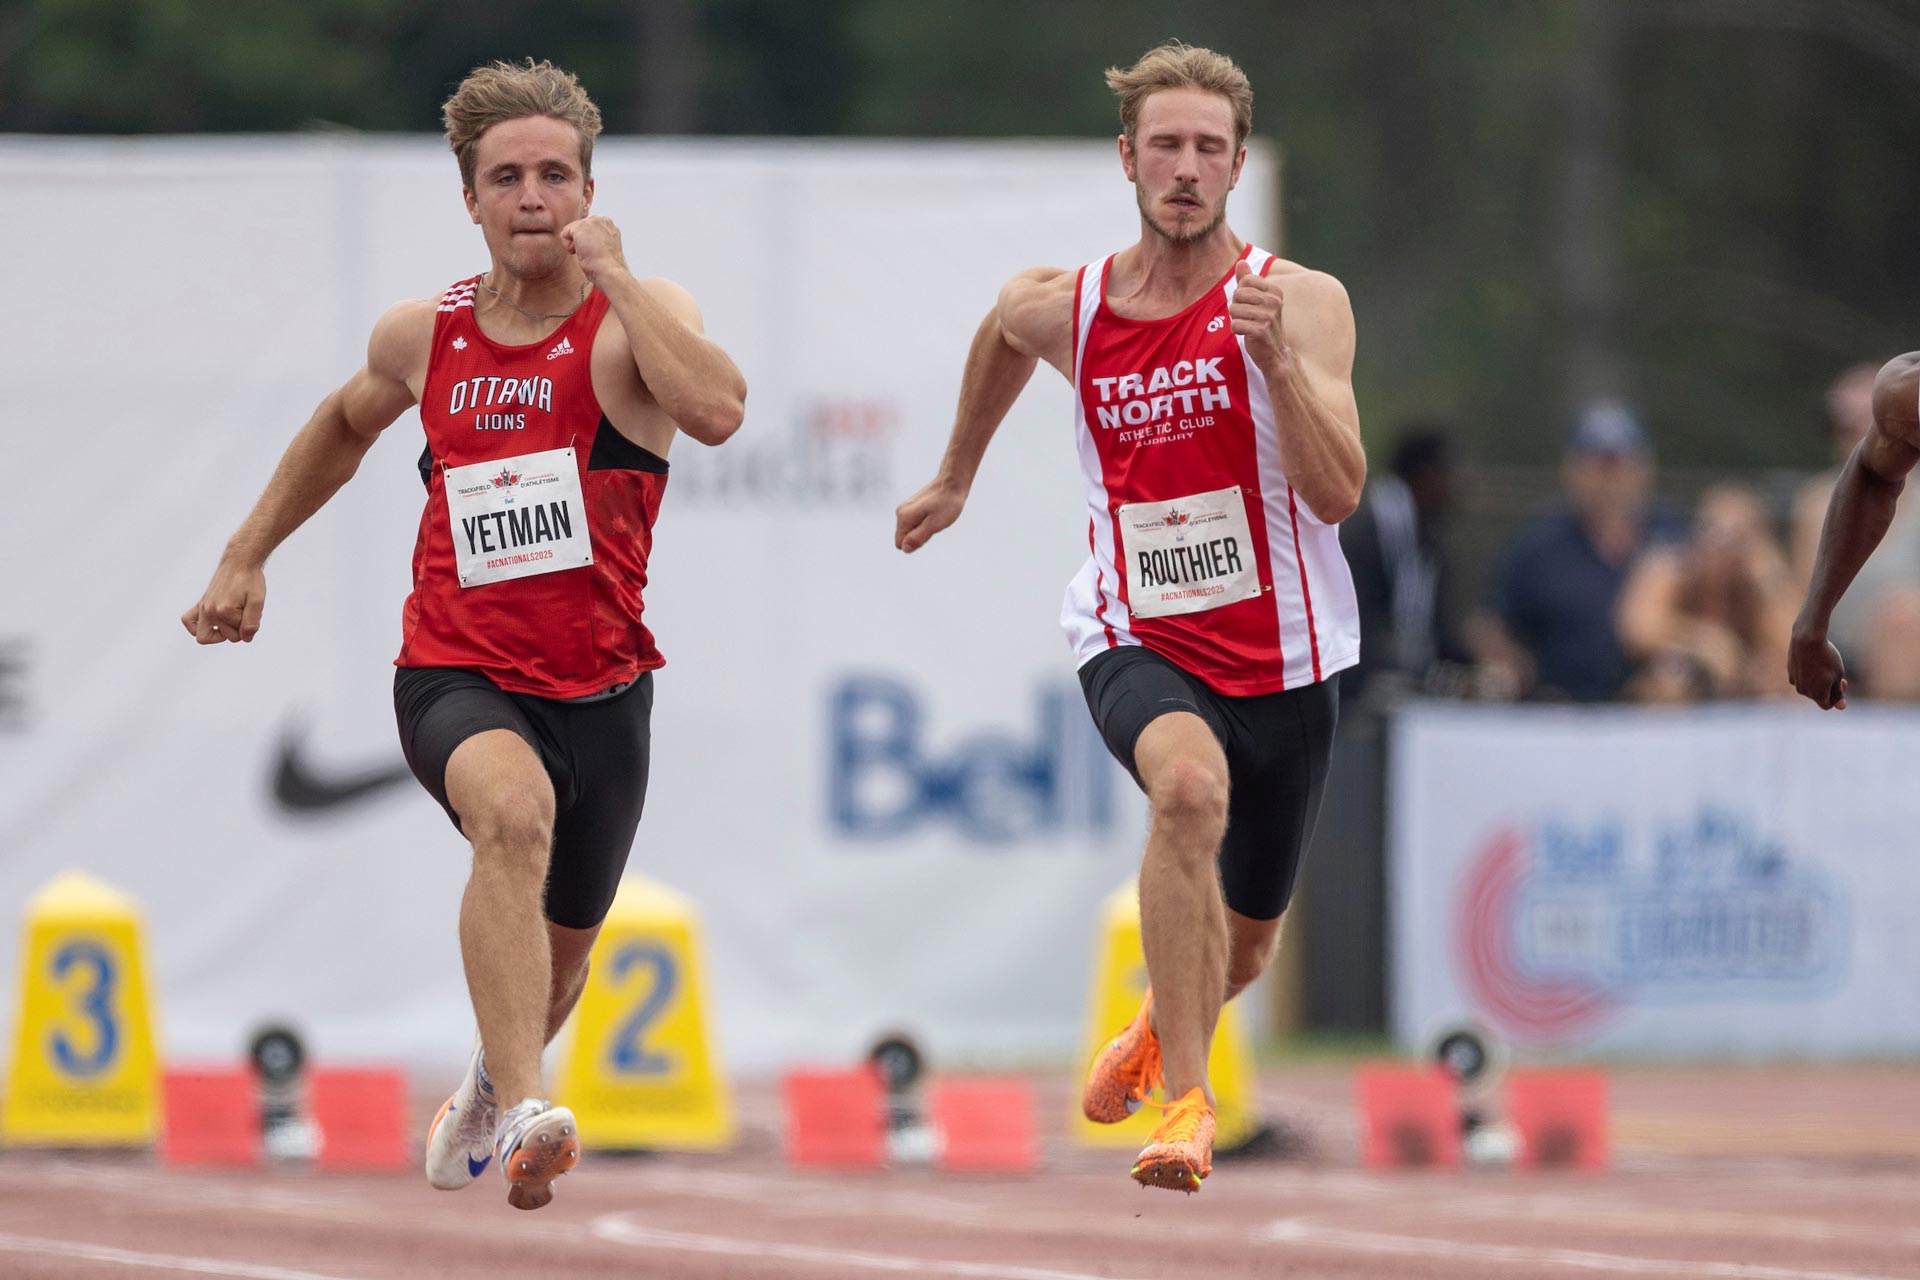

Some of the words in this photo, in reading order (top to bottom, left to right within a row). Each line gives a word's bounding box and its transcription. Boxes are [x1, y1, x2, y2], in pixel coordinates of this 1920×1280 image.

[546, 347, 574, 360] adidas
[449, 375, 553, 415] OTTAWA
[1092, 357, 1226, 402] TRACK
[475, 413, 525, 430] LIONS
[1096, 385, 1231, 429] NORTH
[1119, 422, 1172, 443] ATHLETIC
[1179, 416, 1215, 430] CLUB
[1136, 432, 1194, 448] SUDBURY
[462, 500, 572, 555] YETMAN
[487, 549, 553, 569] #ACNATIONALS2025
[1138, 537, 1242, 587] ROUTHIER
[1161, 584, 1225, 601] #ACNATIONALS2025
[50, 937, 120, 1079] 3
[610, 938, 678, 1077] 2
